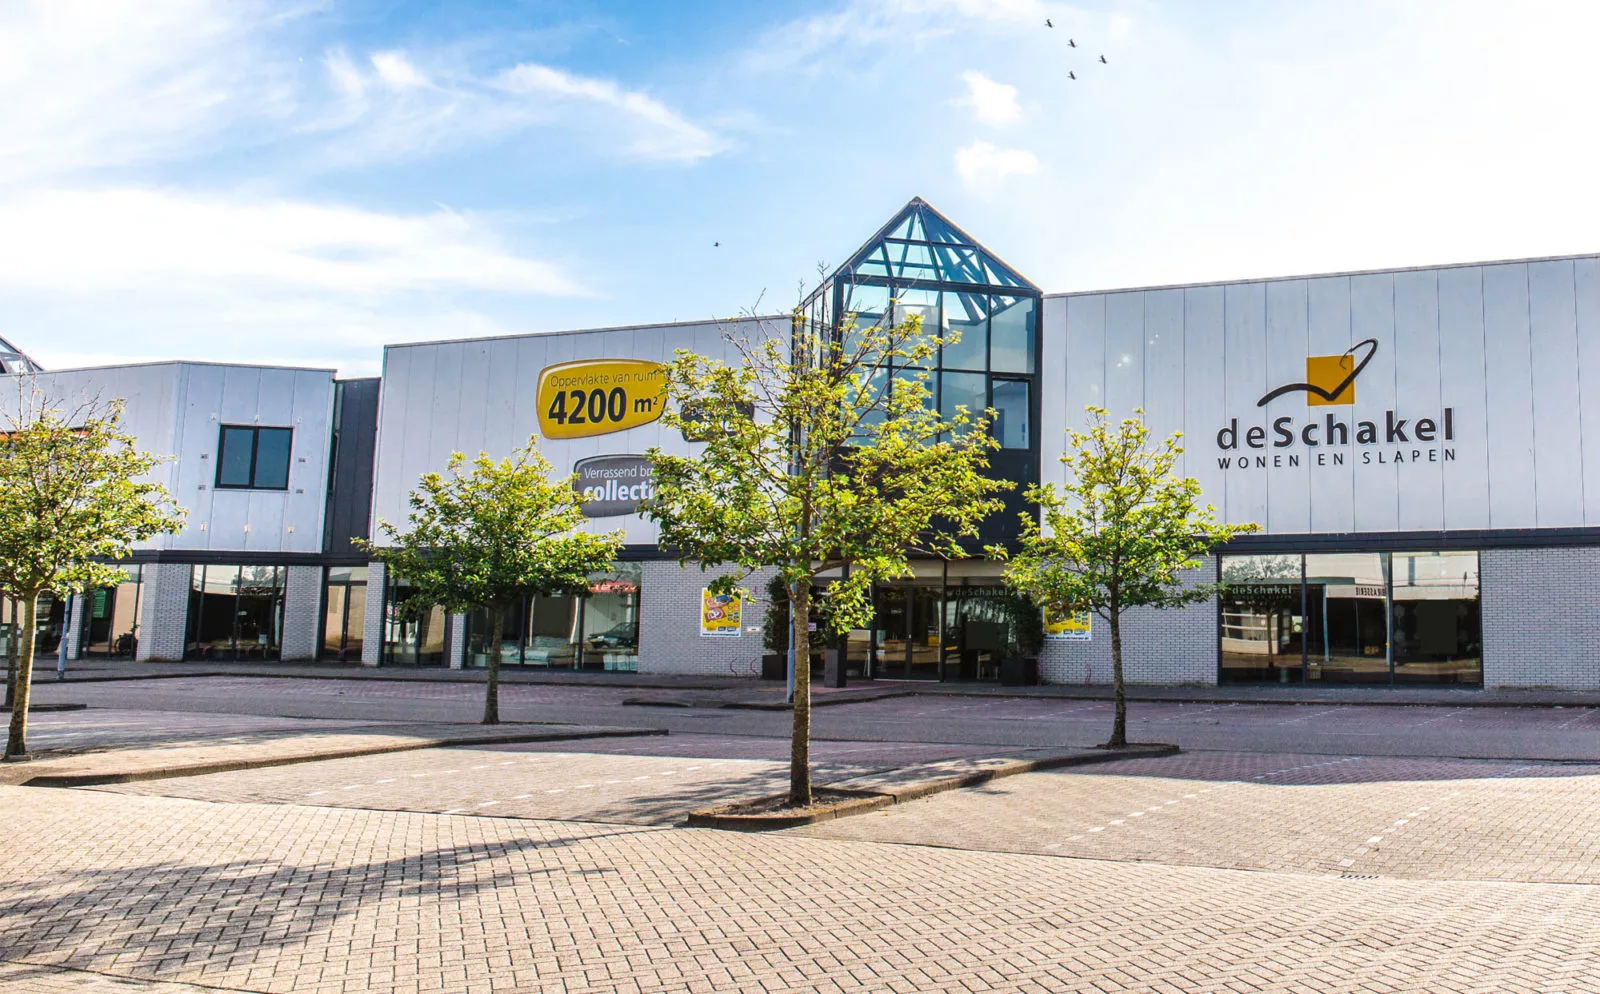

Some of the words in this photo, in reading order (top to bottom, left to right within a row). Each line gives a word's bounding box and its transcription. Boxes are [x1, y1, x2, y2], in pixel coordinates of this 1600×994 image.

[550, 373, 609, 389] Oppervlakte
[612, 373, 630, 383] van
[633, 370, 657, 382] ruim
[548, 387, 627, 424] 4200
[1217, 408, 1453, 449] deSchakel
[1218, 454, 1299, 469] WONEN
[1318, 453, 1343, 465] EN
[1363, 449, 1455, 464] SLAPEN
[584, 466, 637, 479] Verrassend
